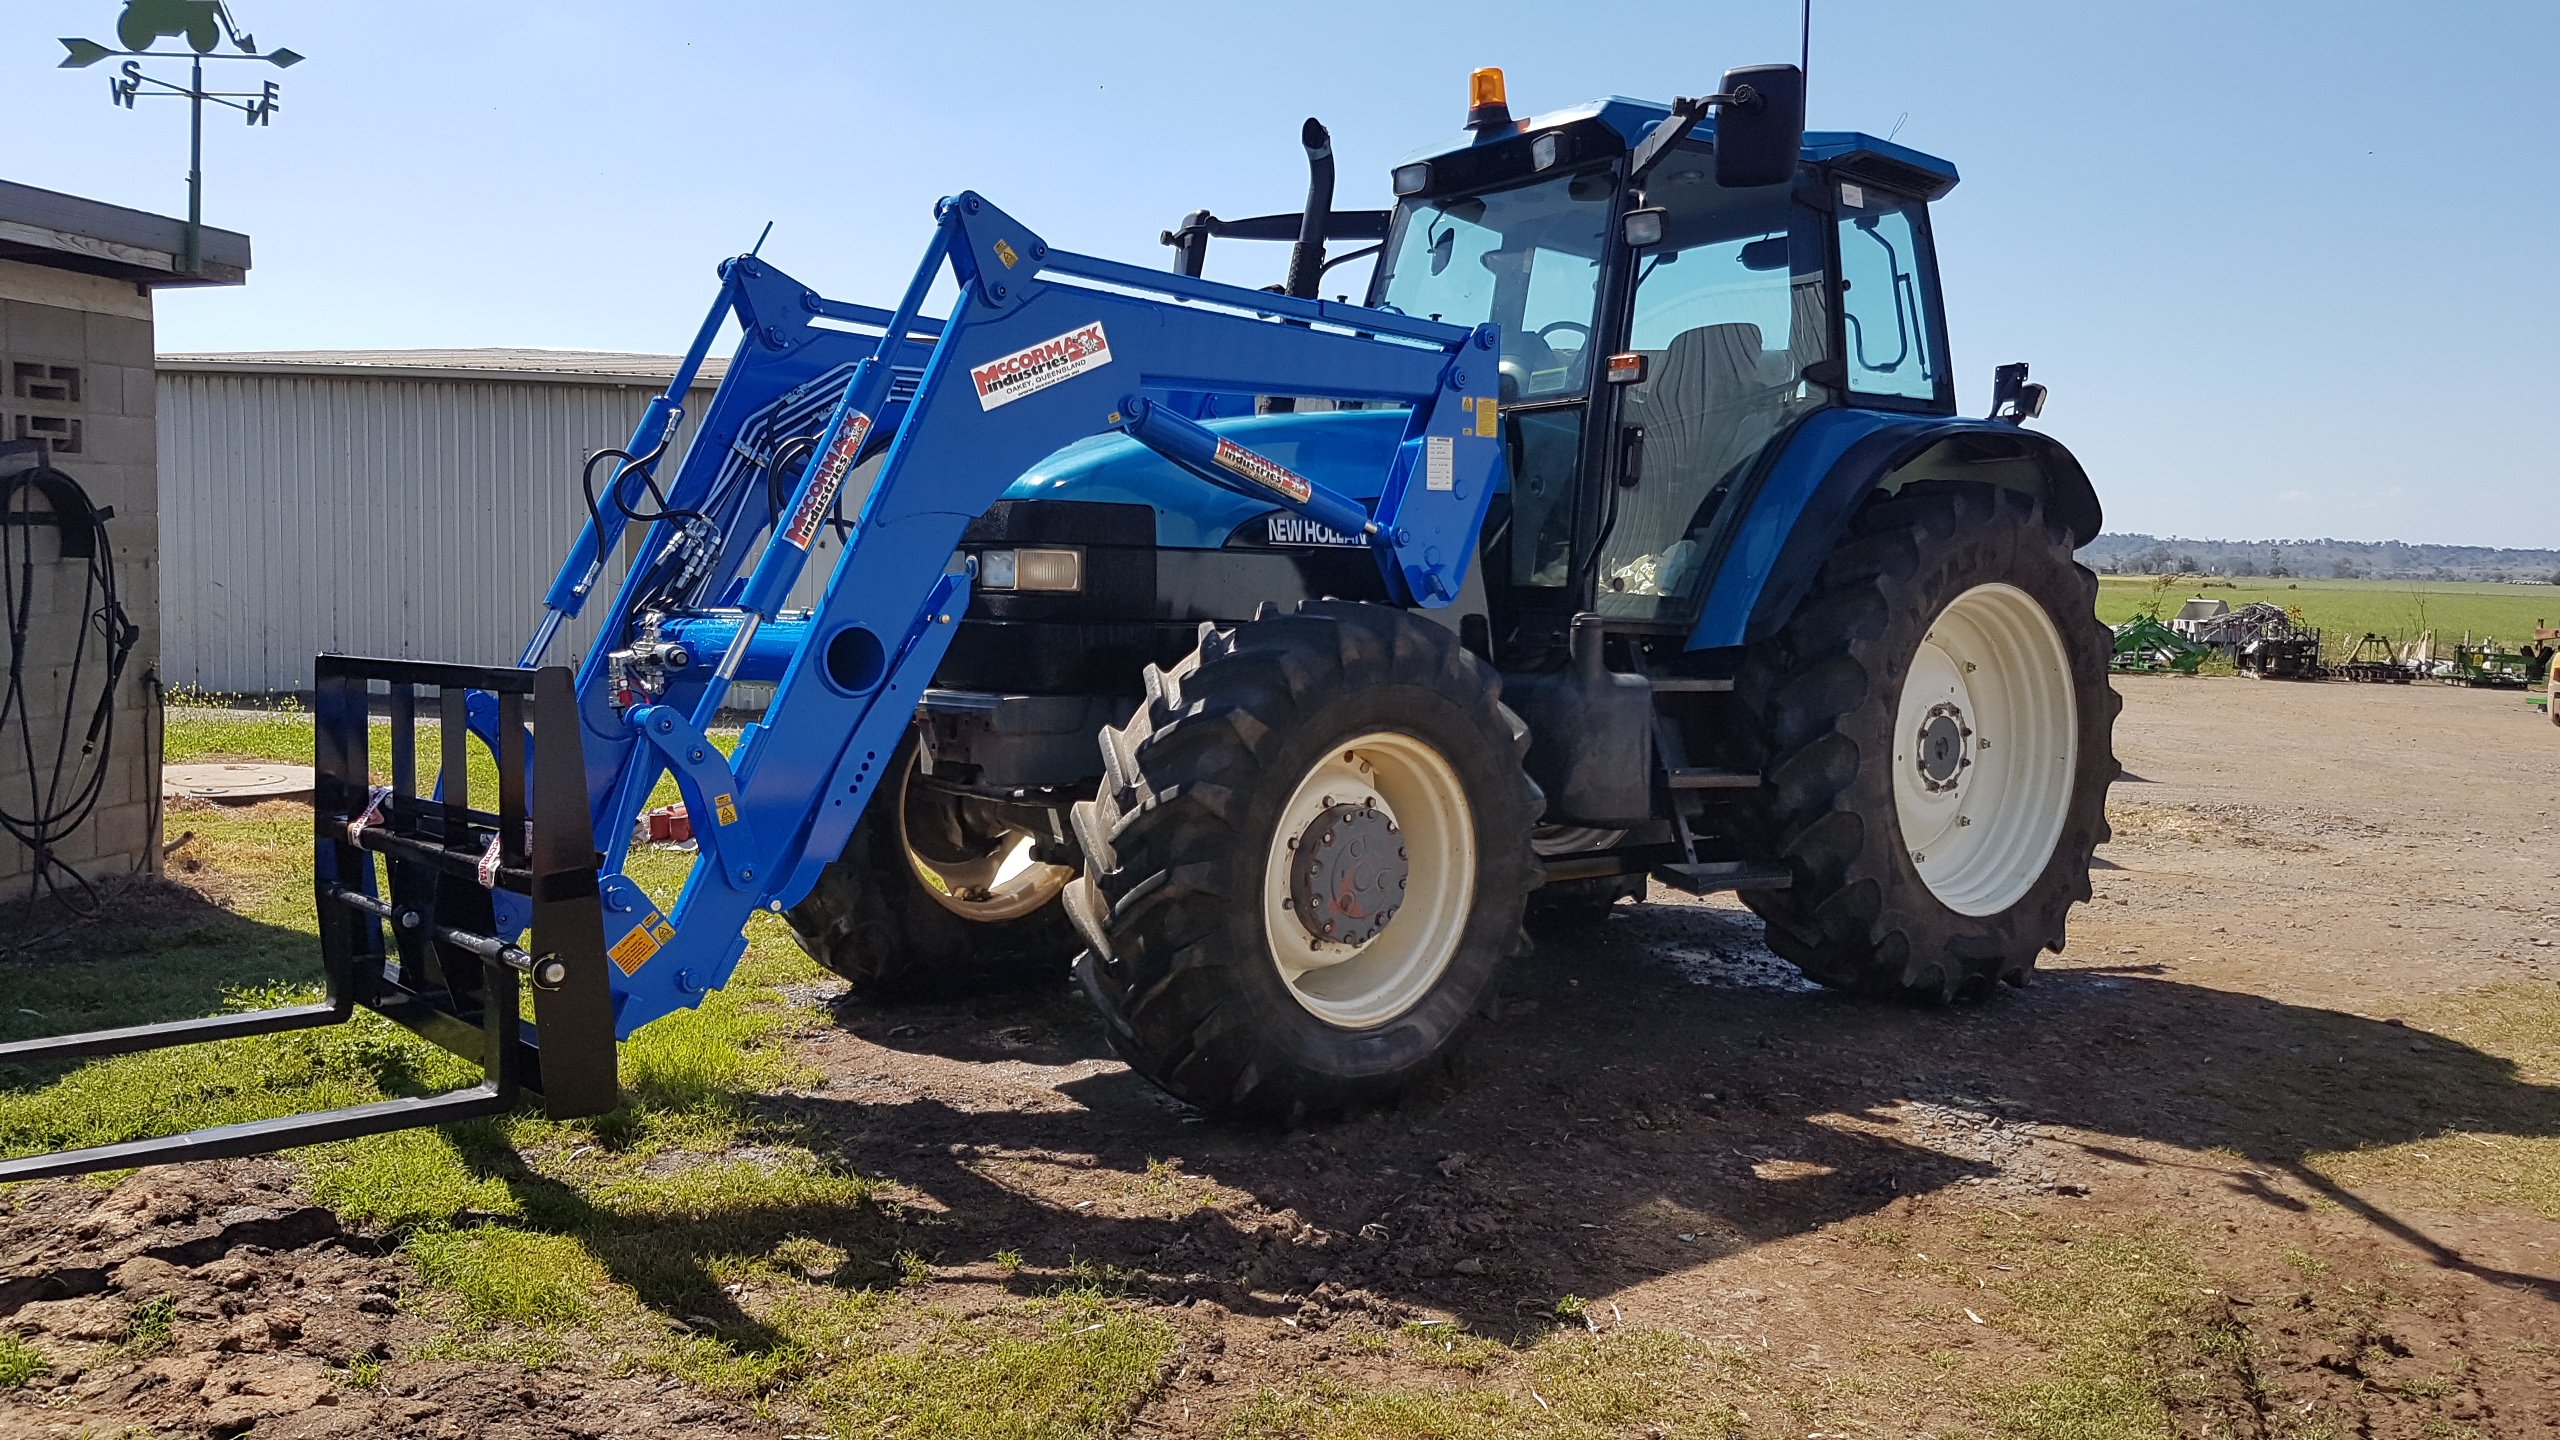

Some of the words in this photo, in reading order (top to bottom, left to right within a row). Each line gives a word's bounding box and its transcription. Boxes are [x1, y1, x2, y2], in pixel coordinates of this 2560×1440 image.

[109, 76, 136, 110] W
[121, 60, 140, 93] S
[263, 79, 279, 112] E
[987, 354, 1069, 393] industries
[1006, 380, 1035, 395] OAKEY,
[1035, 359, 1087, 383] QUEENSLAND
[801, 455, 848, 538] industries
[1268, 518, 1302, 542] NEW
